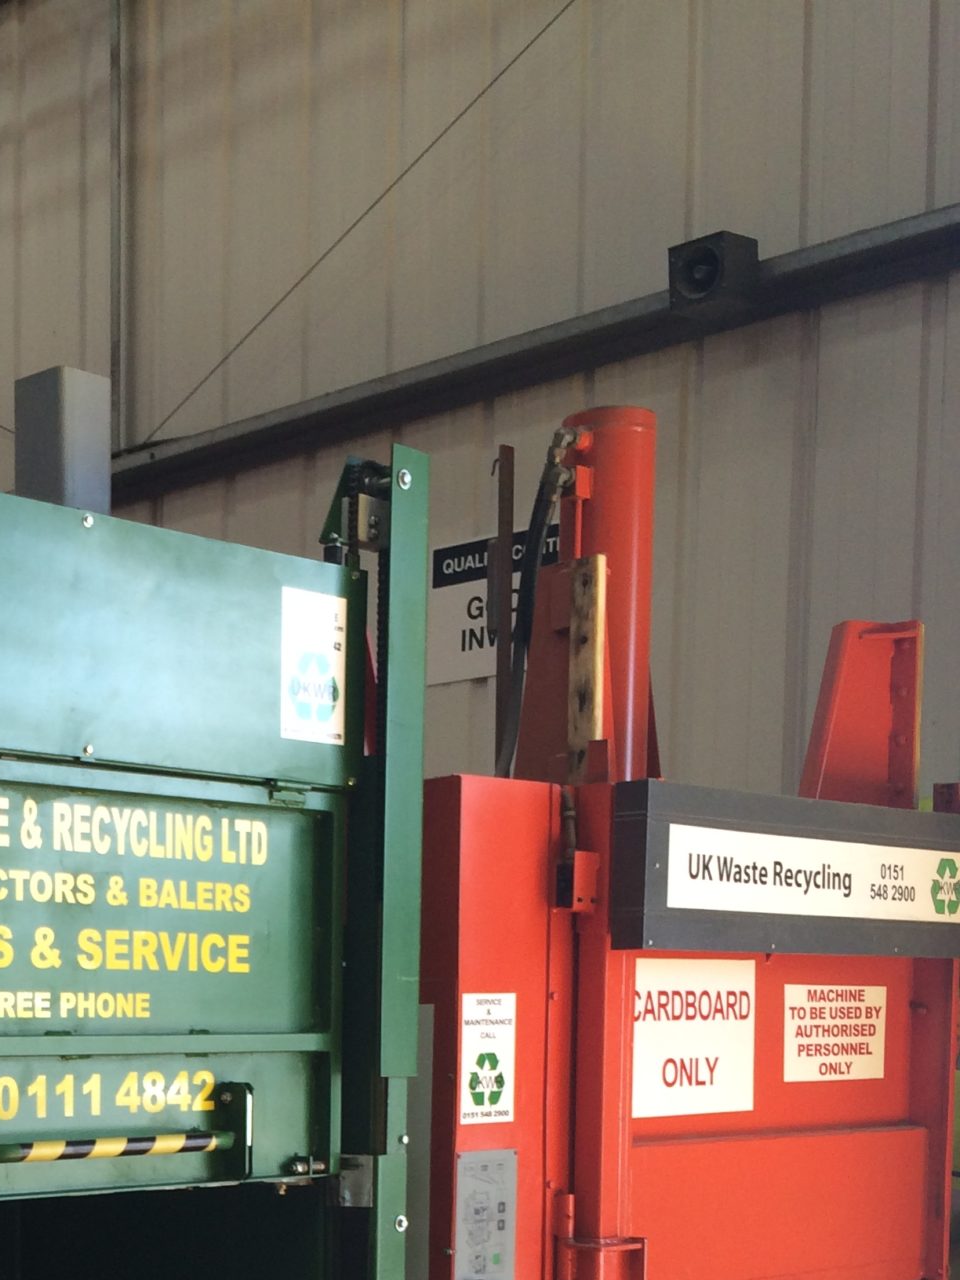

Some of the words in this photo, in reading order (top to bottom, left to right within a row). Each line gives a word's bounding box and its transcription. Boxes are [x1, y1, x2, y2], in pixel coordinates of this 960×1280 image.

[442, 551, 488, 574] QUALI
[20, 796, 43, 849] &
[53, 802, 214, 863] RECYCLING
[221, 818, 269, 866] LTD
[688, 853, 713, 881] UK
[717, 856, 768, 885] Waste
[773, 861, 853, 897] Recycling
[880, 863, 905, 881] 0151
[106, 874, 129, 907] &
[139, 878, 251, 913] BALERS
[870, 884, 888, 901] 548
[891, 885, 916, 902] 2900
[30, 927, 62, 970] &
[77, 928, 250, 973] SERVICE
[59, 992, 150, 1019] PHONE
[807, 989, 865, 1003] MACHINE
[464, 1018, 513, 1026] MAINTENANCE
[789, 1007, 806, 1020] TO
[809, 1007, 826, 1020] BE
[829, 1007, 862, 1020] USED
[865, 1006, 882, 1019] BY
[795, 1024, 876, 1038] AUTHORISED
[797, 1042, 872, 1057] PERSONNEL
[662, 1057, 719, 1088] ONLY
[818, 1062, 853, 1076] ONLY
[27, 1074, 101, 1119] 111
[115, 1070, 216, 1114] 4842
